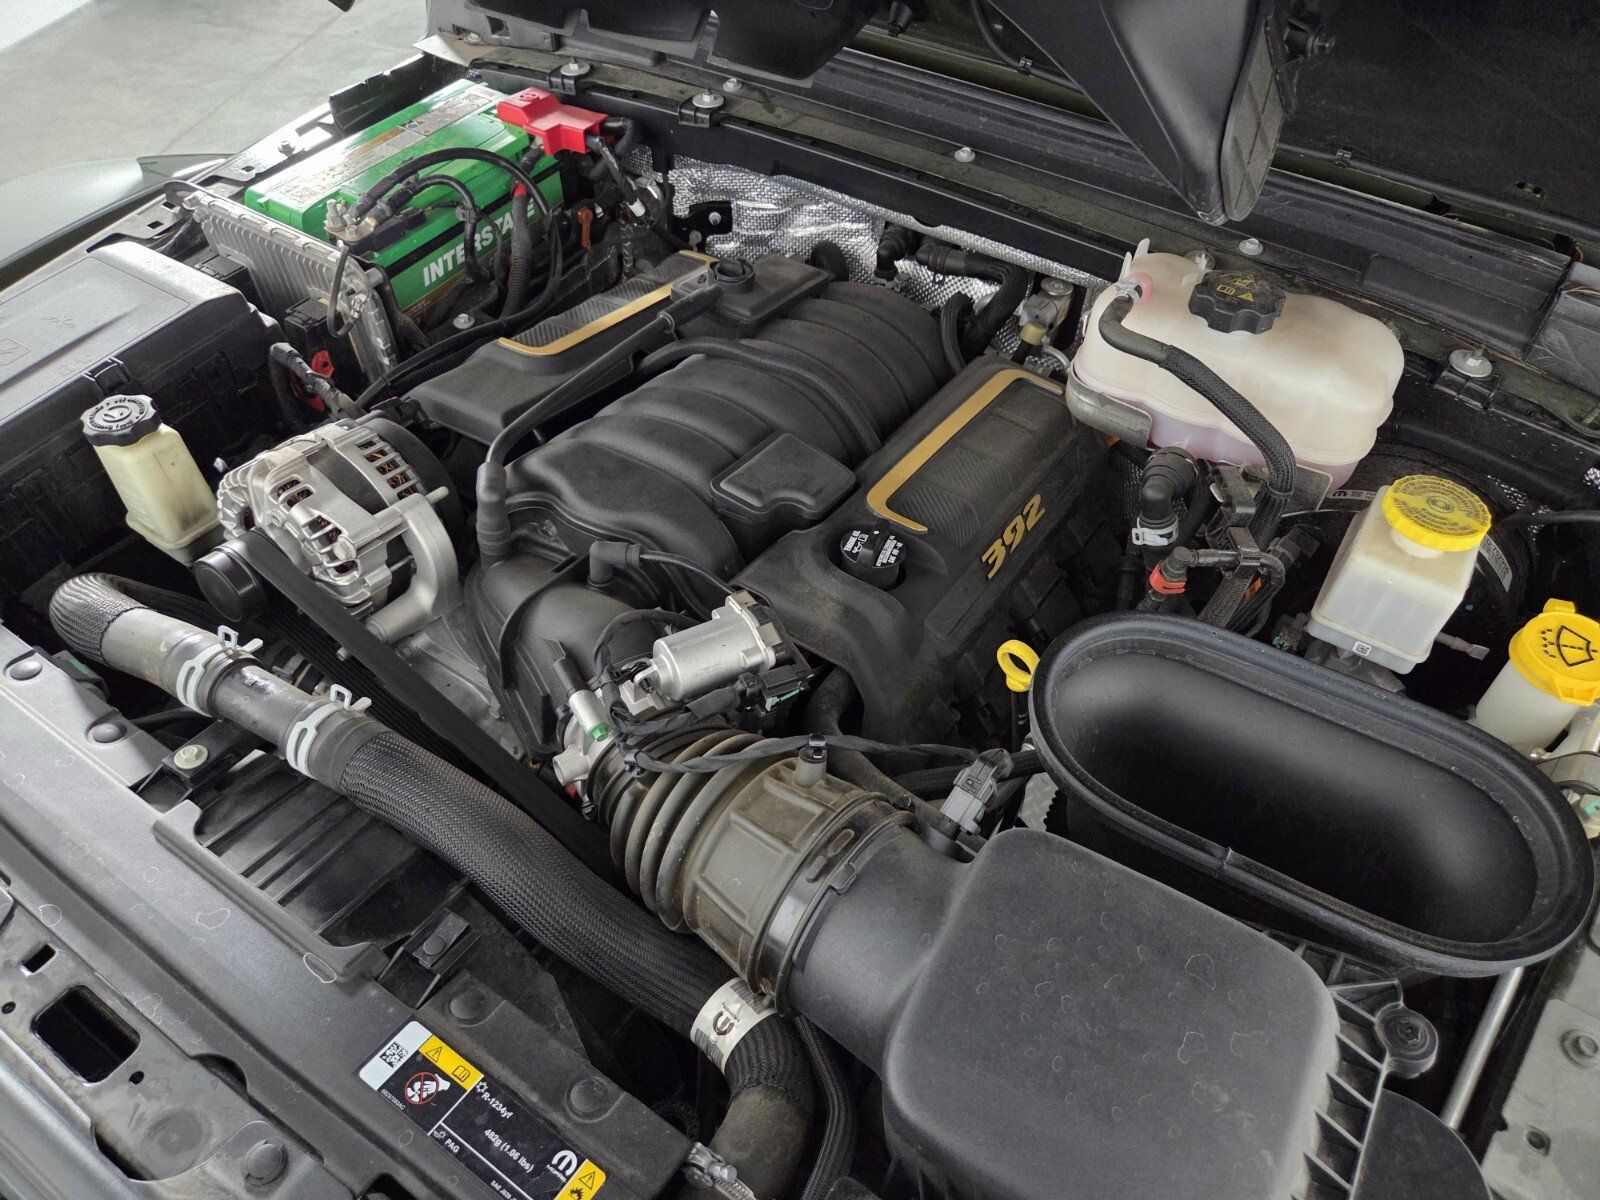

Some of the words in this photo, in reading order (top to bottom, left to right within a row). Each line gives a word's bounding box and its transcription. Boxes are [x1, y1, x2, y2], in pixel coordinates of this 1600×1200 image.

[422, 198, 535, 287] INTERSTAE
[981, 493, 1046, 580] 392
[481, 1091, 514, 1119] R-1234yf
[444, 1138, 460, 1153] PAG
[500, 1142, 520, 1160] (1.06
[517, 1156, 534, 1173] lbs)
